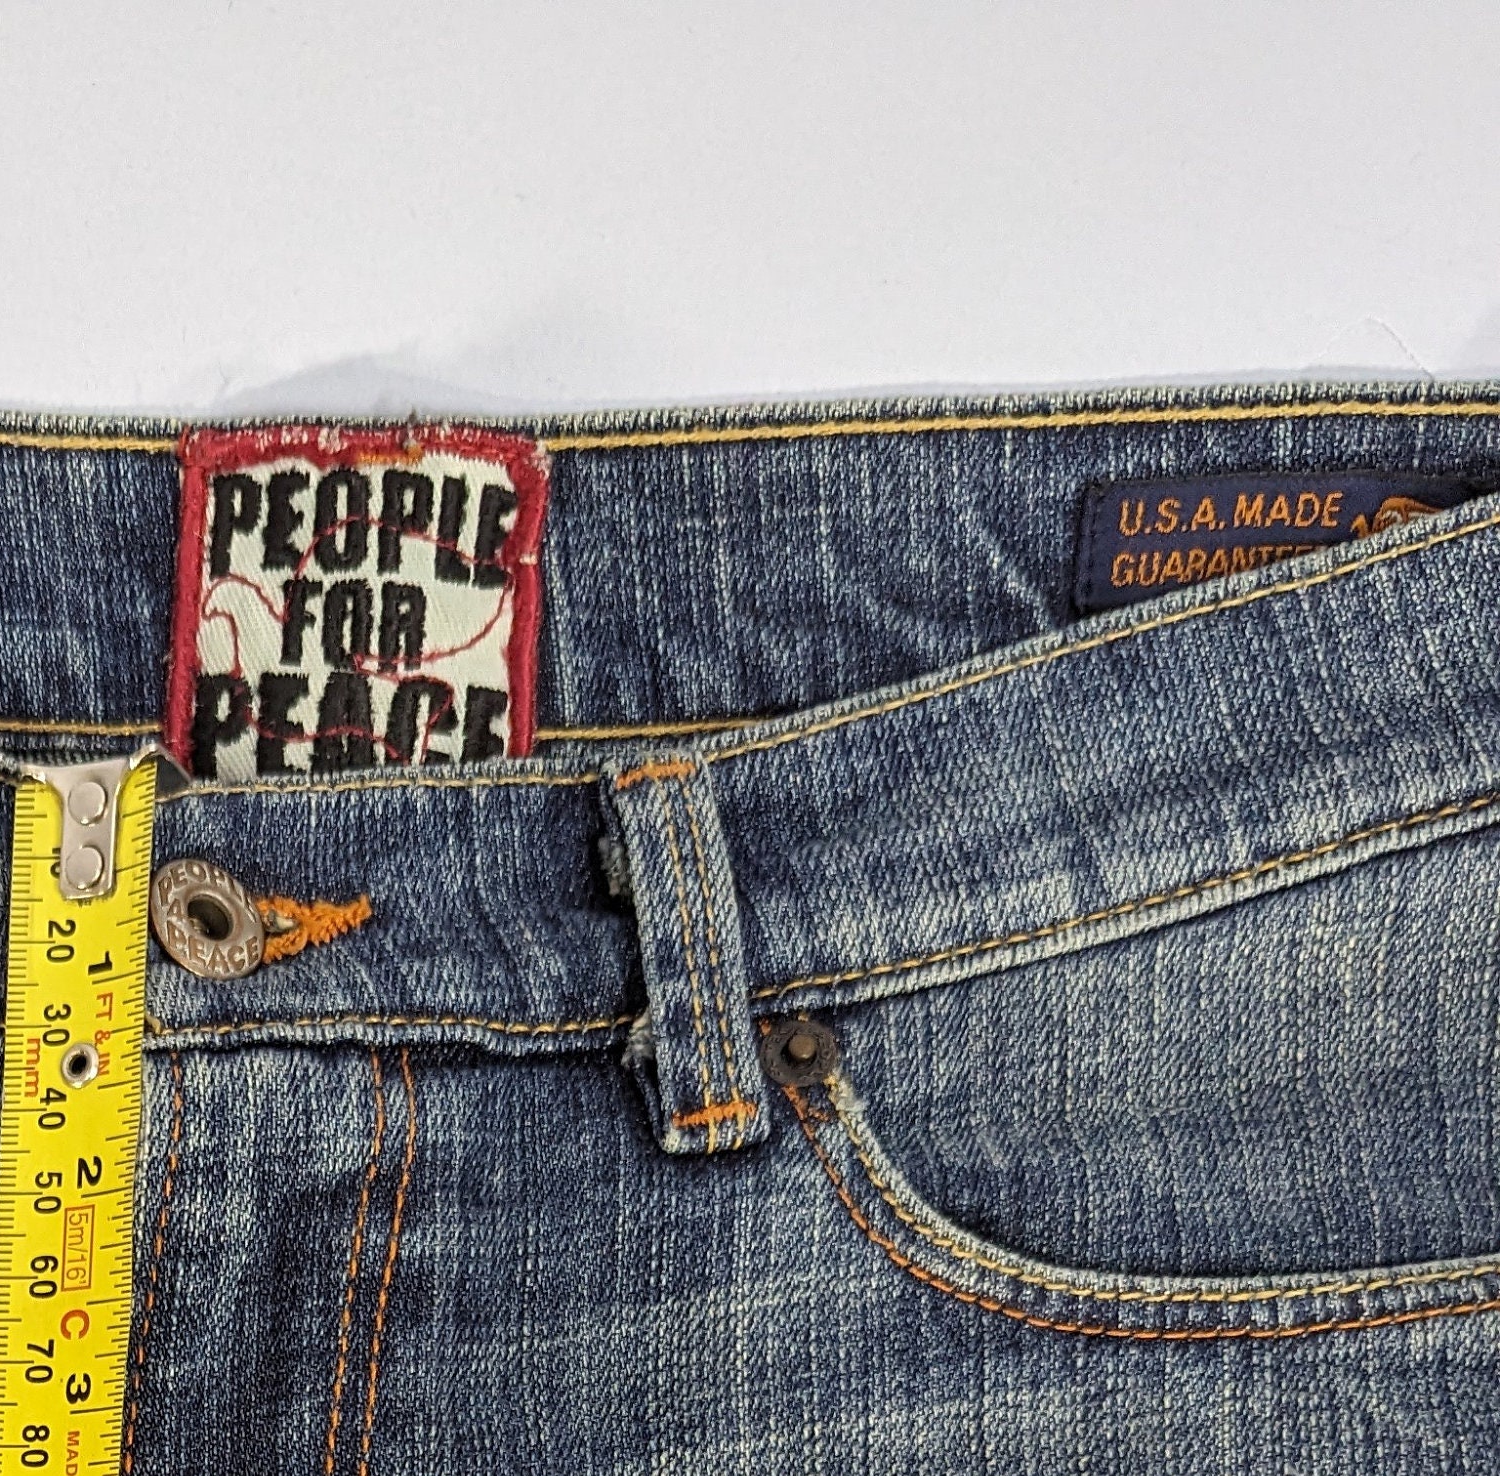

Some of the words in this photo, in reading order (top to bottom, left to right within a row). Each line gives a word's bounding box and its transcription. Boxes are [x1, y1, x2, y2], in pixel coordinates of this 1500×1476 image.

[210, 468, 518, 588] PEOPLE
[1118, 497, 1226, 537] U.S.A.
[1232, 491, 1345, 528] MADE
[280, 577, 427, 671] FOR
[190, 671, 508, 778] PEACE
[46, 920, 76, 963] 20
[88, 951, 113, 975] 1
[166, 919, 259, 974] PEACE
[42, 1004, 71, 1047] 30
[96, 992, 113, 1021] FT
[94, 1030, 111, 1046] &
[24, 1038, 41, 1098] mm
[98, 1053, 111, 1076] IN
[38, 1087, 67, 1131] 40
[34, 1171, 62, 1215] 50
[77, 1156, 103, 1189] 2
[29, 1255, 59, 1299] 60
[60, 1309, 90, 1340] C
[24, 1339, 55, 1384] 70
[66, 1373, 92, 1404] 3
[20, 1425, 50, 1468] 80
